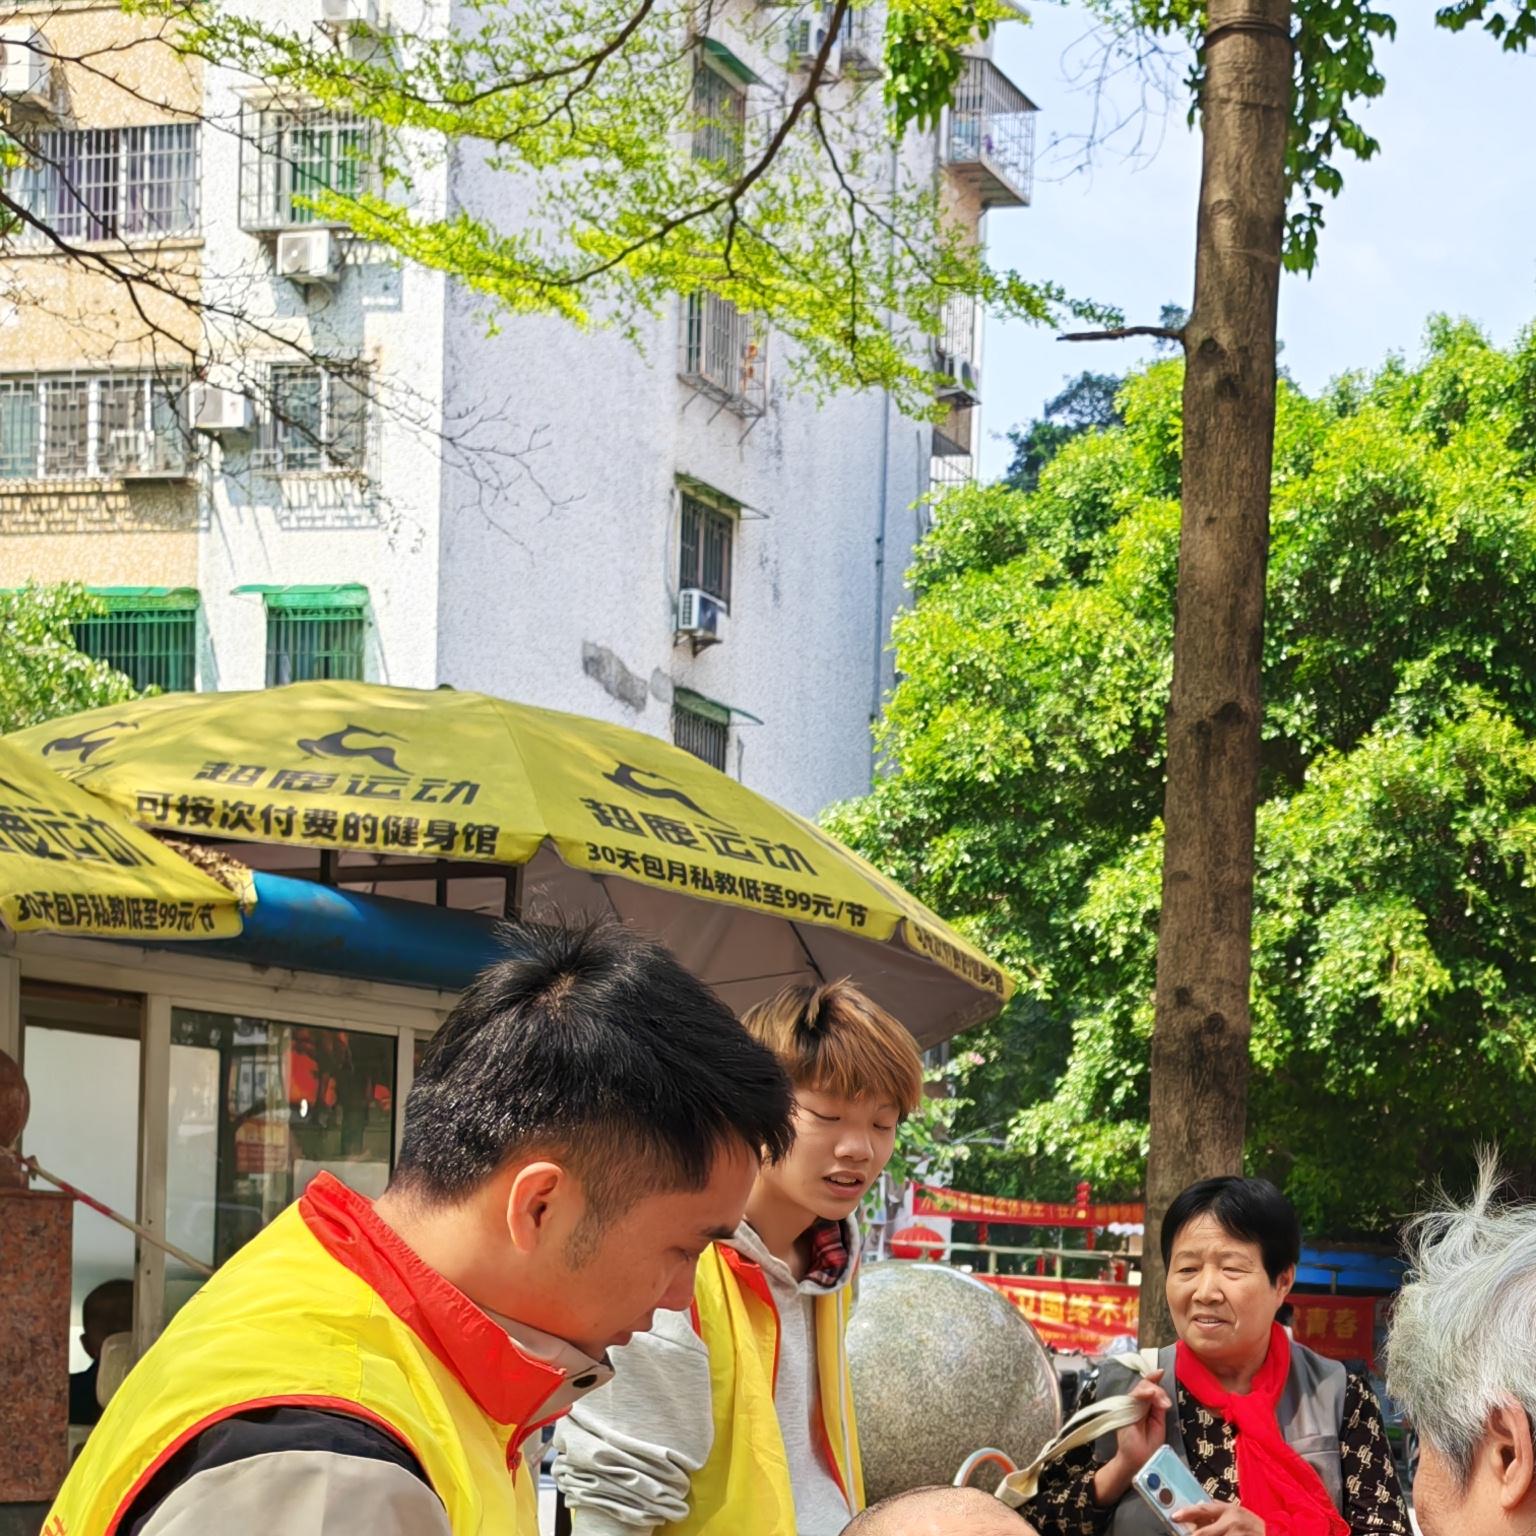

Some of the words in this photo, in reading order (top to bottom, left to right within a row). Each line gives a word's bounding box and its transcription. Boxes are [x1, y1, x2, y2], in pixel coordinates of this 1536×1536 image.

[136, 791, 499, 855] 可按次付费的健身馆
[15, 892, 216, 932] 30天包月私教低至99元/节
[586, 842, 868, 927] 30天包月私教低至99元/节
